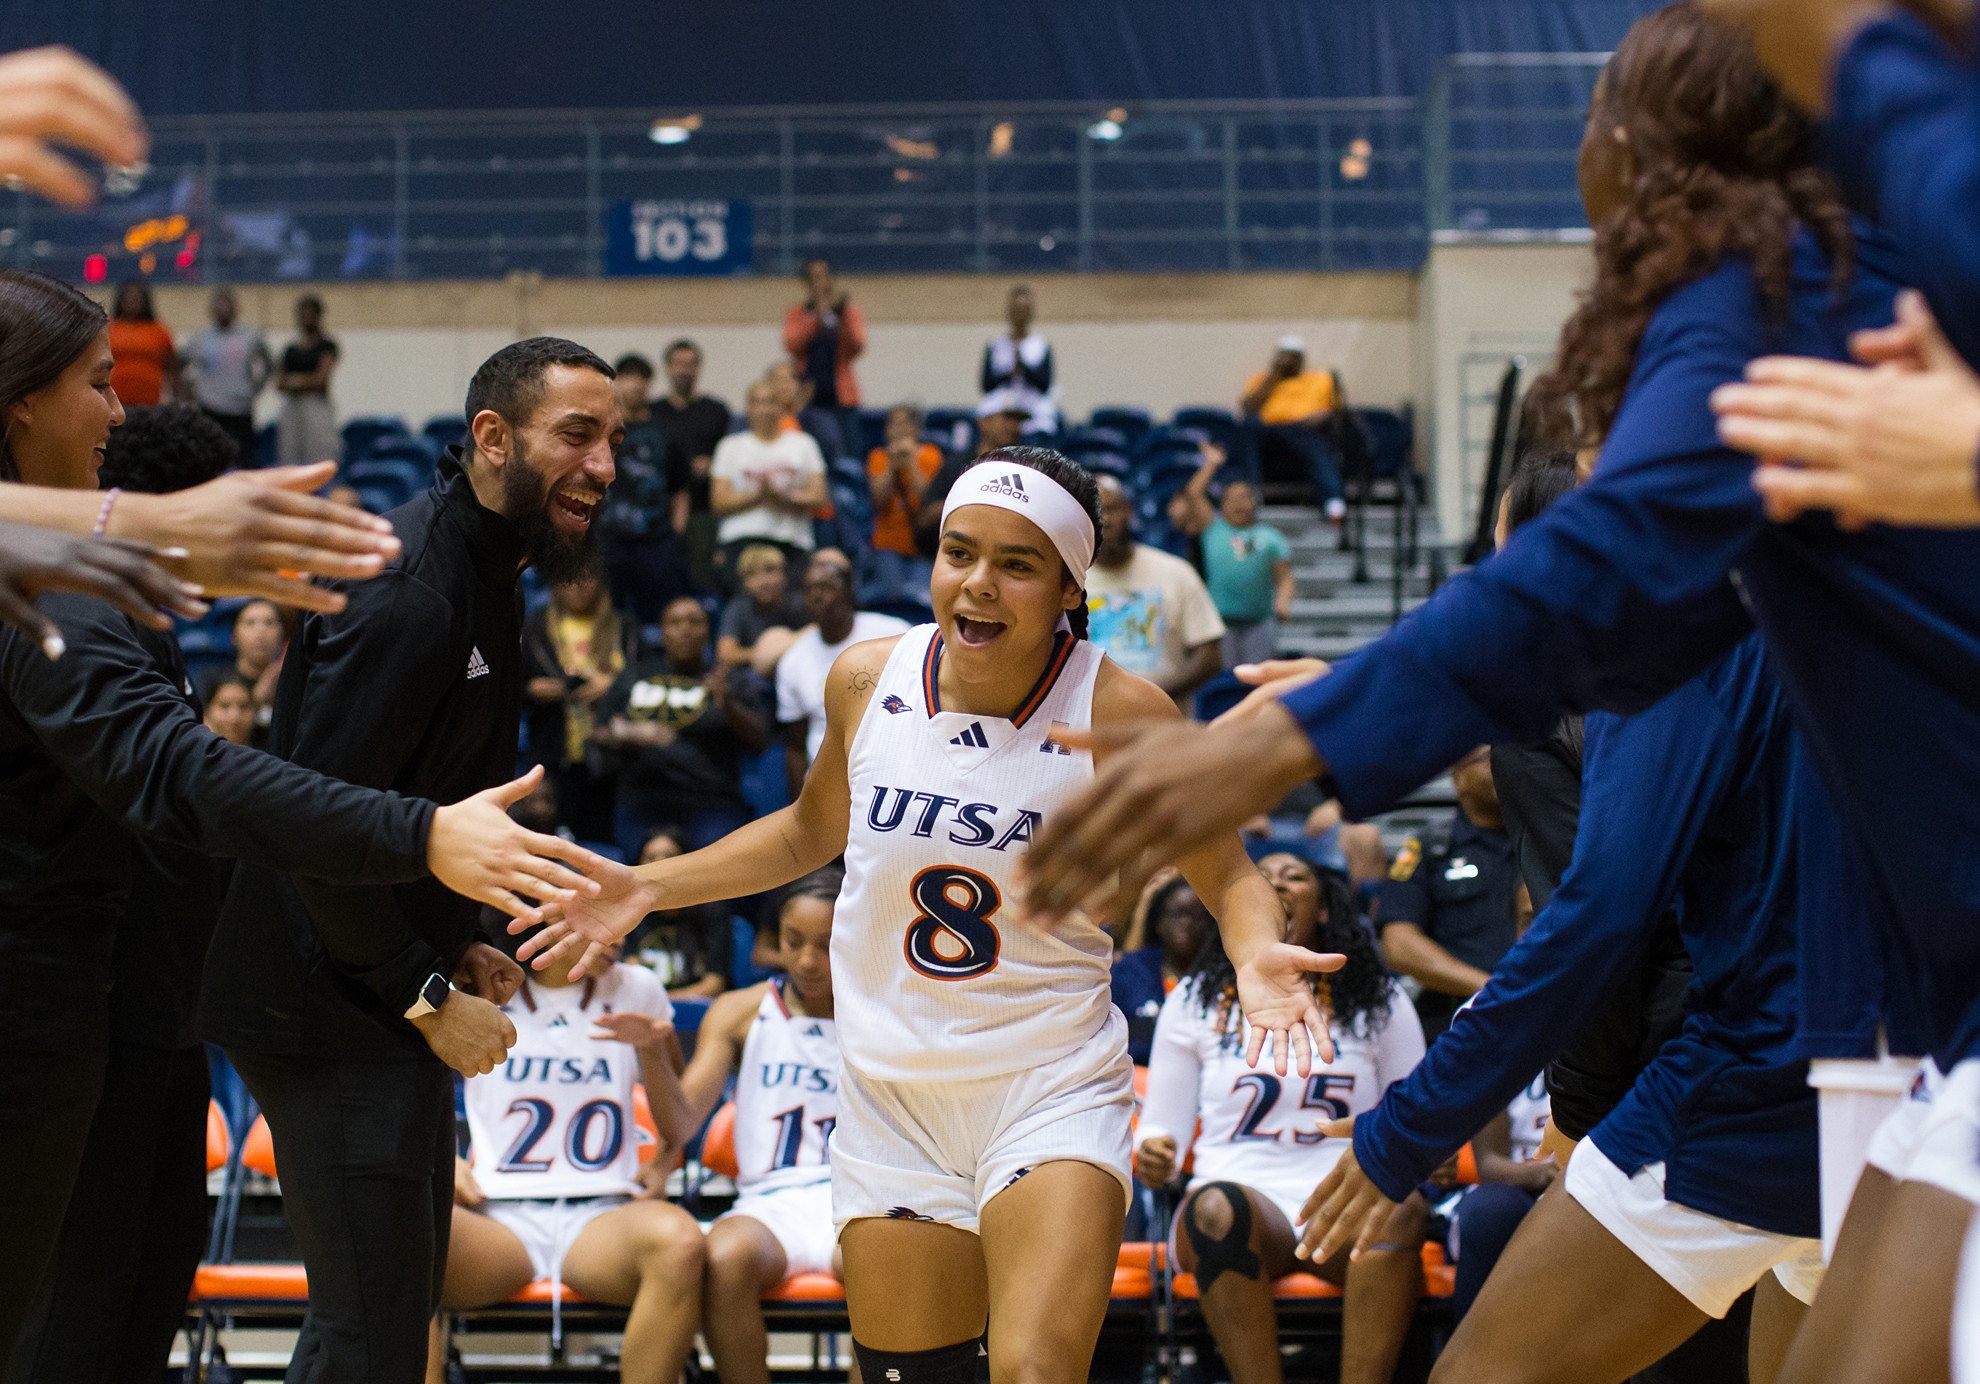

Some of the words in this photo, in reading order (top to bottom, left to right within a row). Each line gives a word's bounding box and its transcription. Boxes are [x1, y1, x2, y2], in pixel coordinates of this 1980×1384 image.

[631, 219, 728, 261] 103
[980, 484, 1030, 503] adidas
[466, 664, 490, 679] adidas
[867, 785, 1044, 851] UTSA
[904, 864, 1002, 982] 8
[504, 1056, 613, 1084] UTSA
[762, 1063, 837, 1095] UTS
[1228, 1072, 1356, 1147] 25
[494, 1096, 624, 1174] 20
